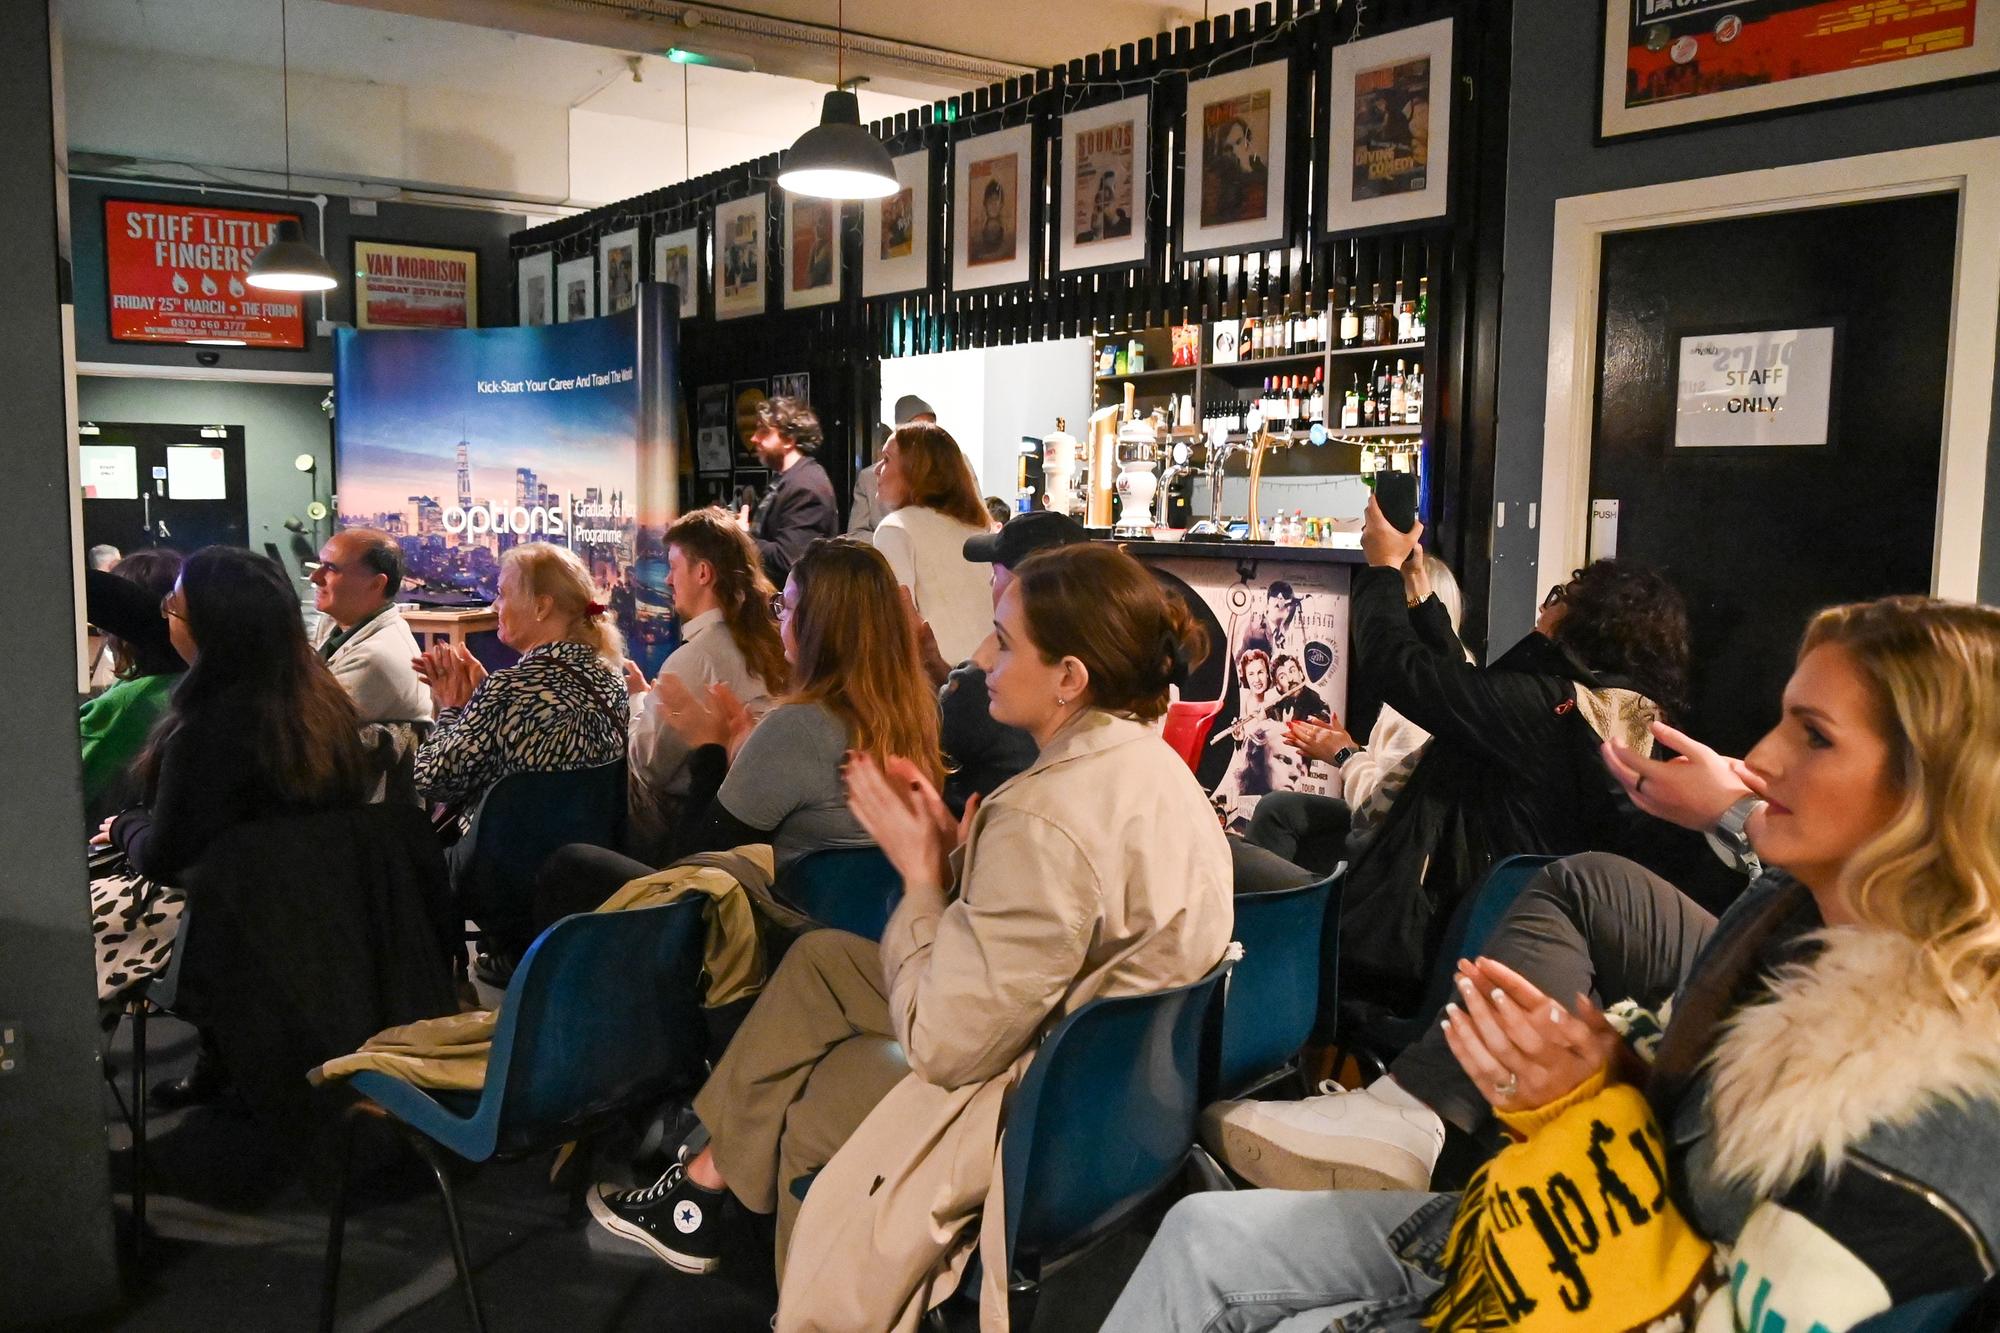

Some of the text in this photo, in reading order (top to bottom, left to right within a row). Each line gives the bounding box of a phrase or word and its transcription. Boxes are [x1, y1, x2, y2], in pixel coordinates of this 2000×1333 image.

[127, 212, 194, 243] STIFF
[155, 241, 256, 273] FINGERS
[366, 253, 393, 277] VAN
[397, 256, 467, 283] MORRISON
[113, 294, 156, 311] FRIDAY
[184, 299, 225, 315] MARCH
[241, 301, 260, 316] THE
[262, 303, 298, 318] FORUM
[442, 290, 466, 299] MAY
[477, 380, 525, 393] Kick-Start
[525, 379, 548, 392] Your
[548, 377, 575, 391] Career
[575, 374, 591, 388] And
[592, 371, 611, 387] Travel
[611, 370, 621, 384] The
[1726, 368, 1783, 386] STAFF
[1727, 396, 1780, 414] ONLY
[442, 500, 565, 544] options
[574, 499, 613, 518] Graduate
[1593, 510, 1617, 519] PUSH
[575, 527, 622, 547] Programme
